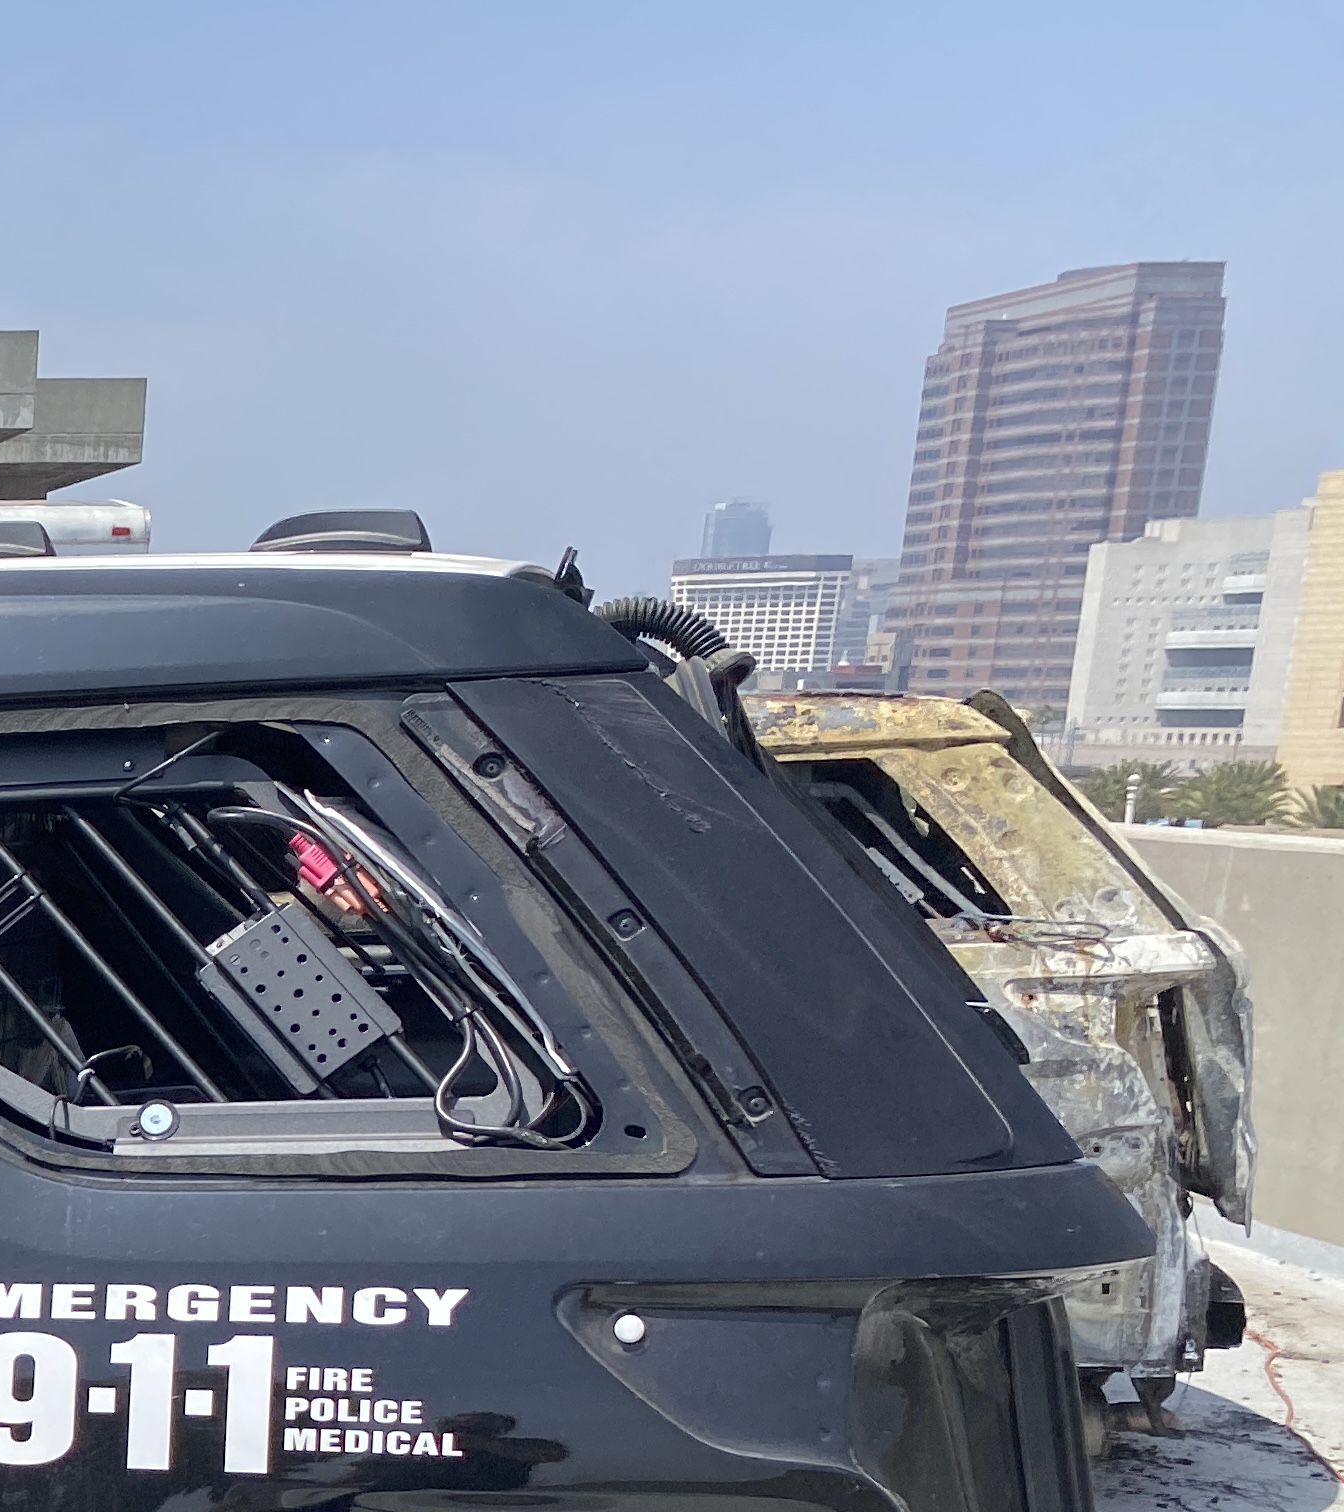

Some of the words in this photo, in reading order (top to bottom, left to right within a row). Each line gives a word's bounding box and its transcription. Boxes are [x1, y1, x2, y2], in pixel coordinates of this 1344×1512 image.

[286, 1366, 373, 1393] FIRE
[284, 1396, 423, 1425] POLICE
[283, 1427, 464, 1458] MEDICAL
